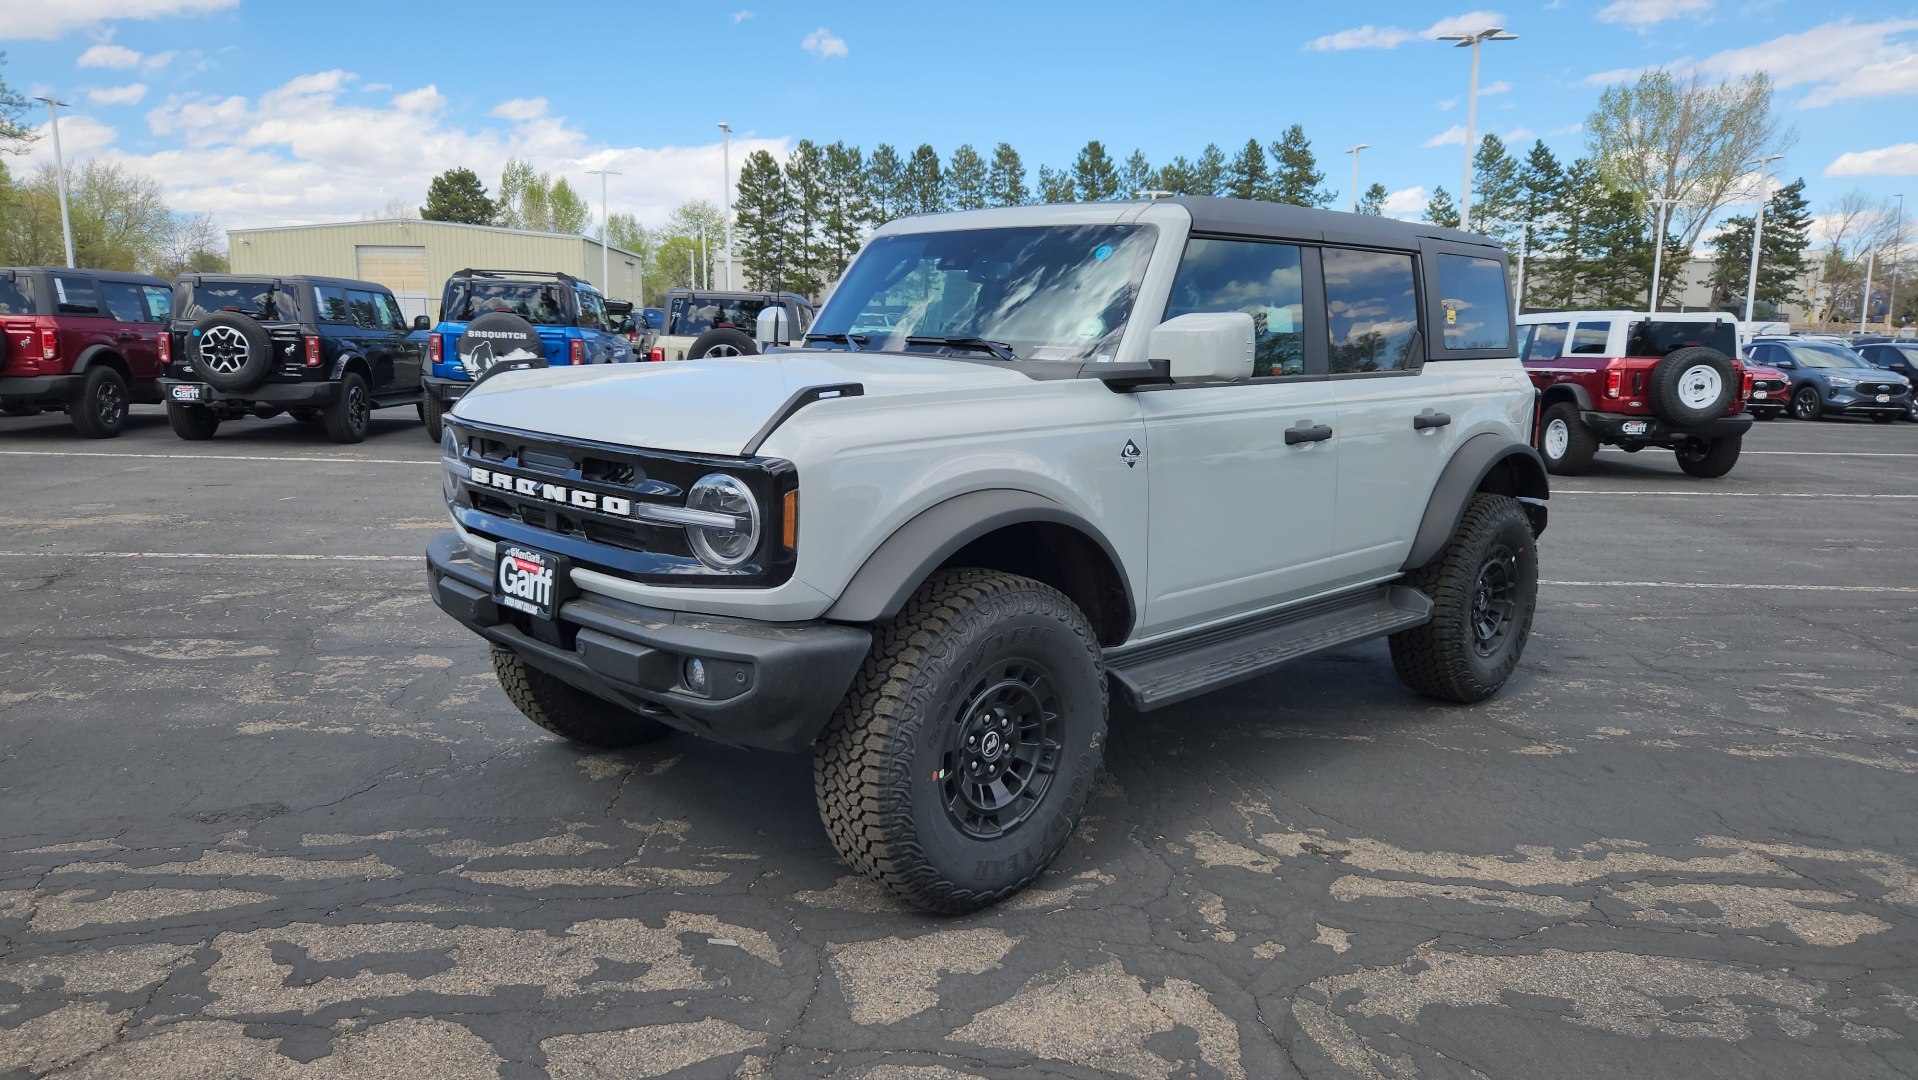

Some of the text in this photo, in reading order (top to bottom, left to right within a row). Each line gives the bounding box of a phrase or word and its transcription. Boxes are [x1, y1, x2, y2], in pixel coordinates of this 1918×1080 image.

[468, 330, 527, 340] SASQUATCH
[172, 387, 200, 399] Garff
[1622, 422, 1647, 433] Garff
[471, 467, 631, 516] BRONCO
[499, 555, 553, 606] Garff
